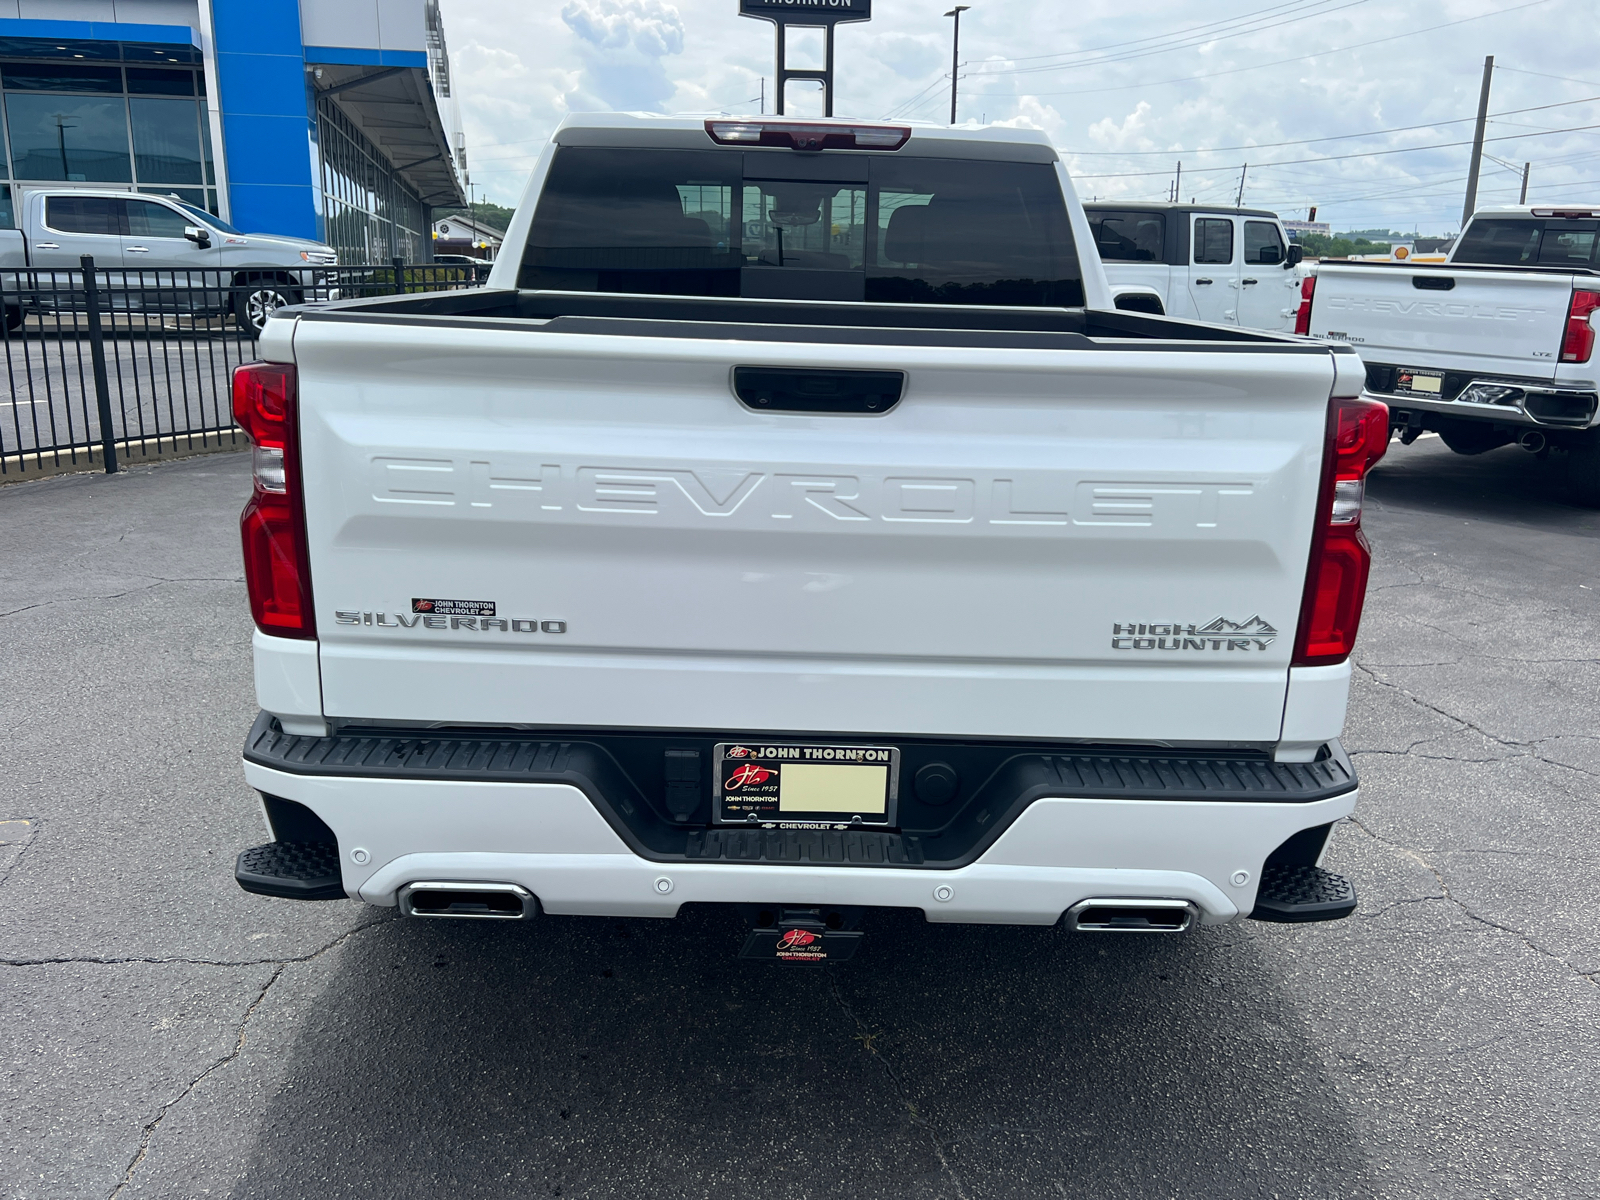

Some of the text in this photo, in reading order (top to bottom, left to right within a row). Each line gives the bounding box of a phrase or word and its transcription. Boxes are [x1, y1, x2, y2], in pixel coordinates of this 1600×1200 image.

[1327, 296, 1546, 322] CHEVROLET
[371, 456, 1254, 528] CHEVROLET
[434, 600, 494, 610] JOHN THORNTON
[434, 607, 480, 615] CHEVROLET
[335, 609, 567, 634] SILVERADO
[1112, 622, 1197, 636] HIGH
[1111, 636, 1276, 651] COUNTRY
[757, 746, 800, 759] JOHN
[803, 748, 889, 761] THORNTON
[779, 822, 831, 830] CHEVROLET
